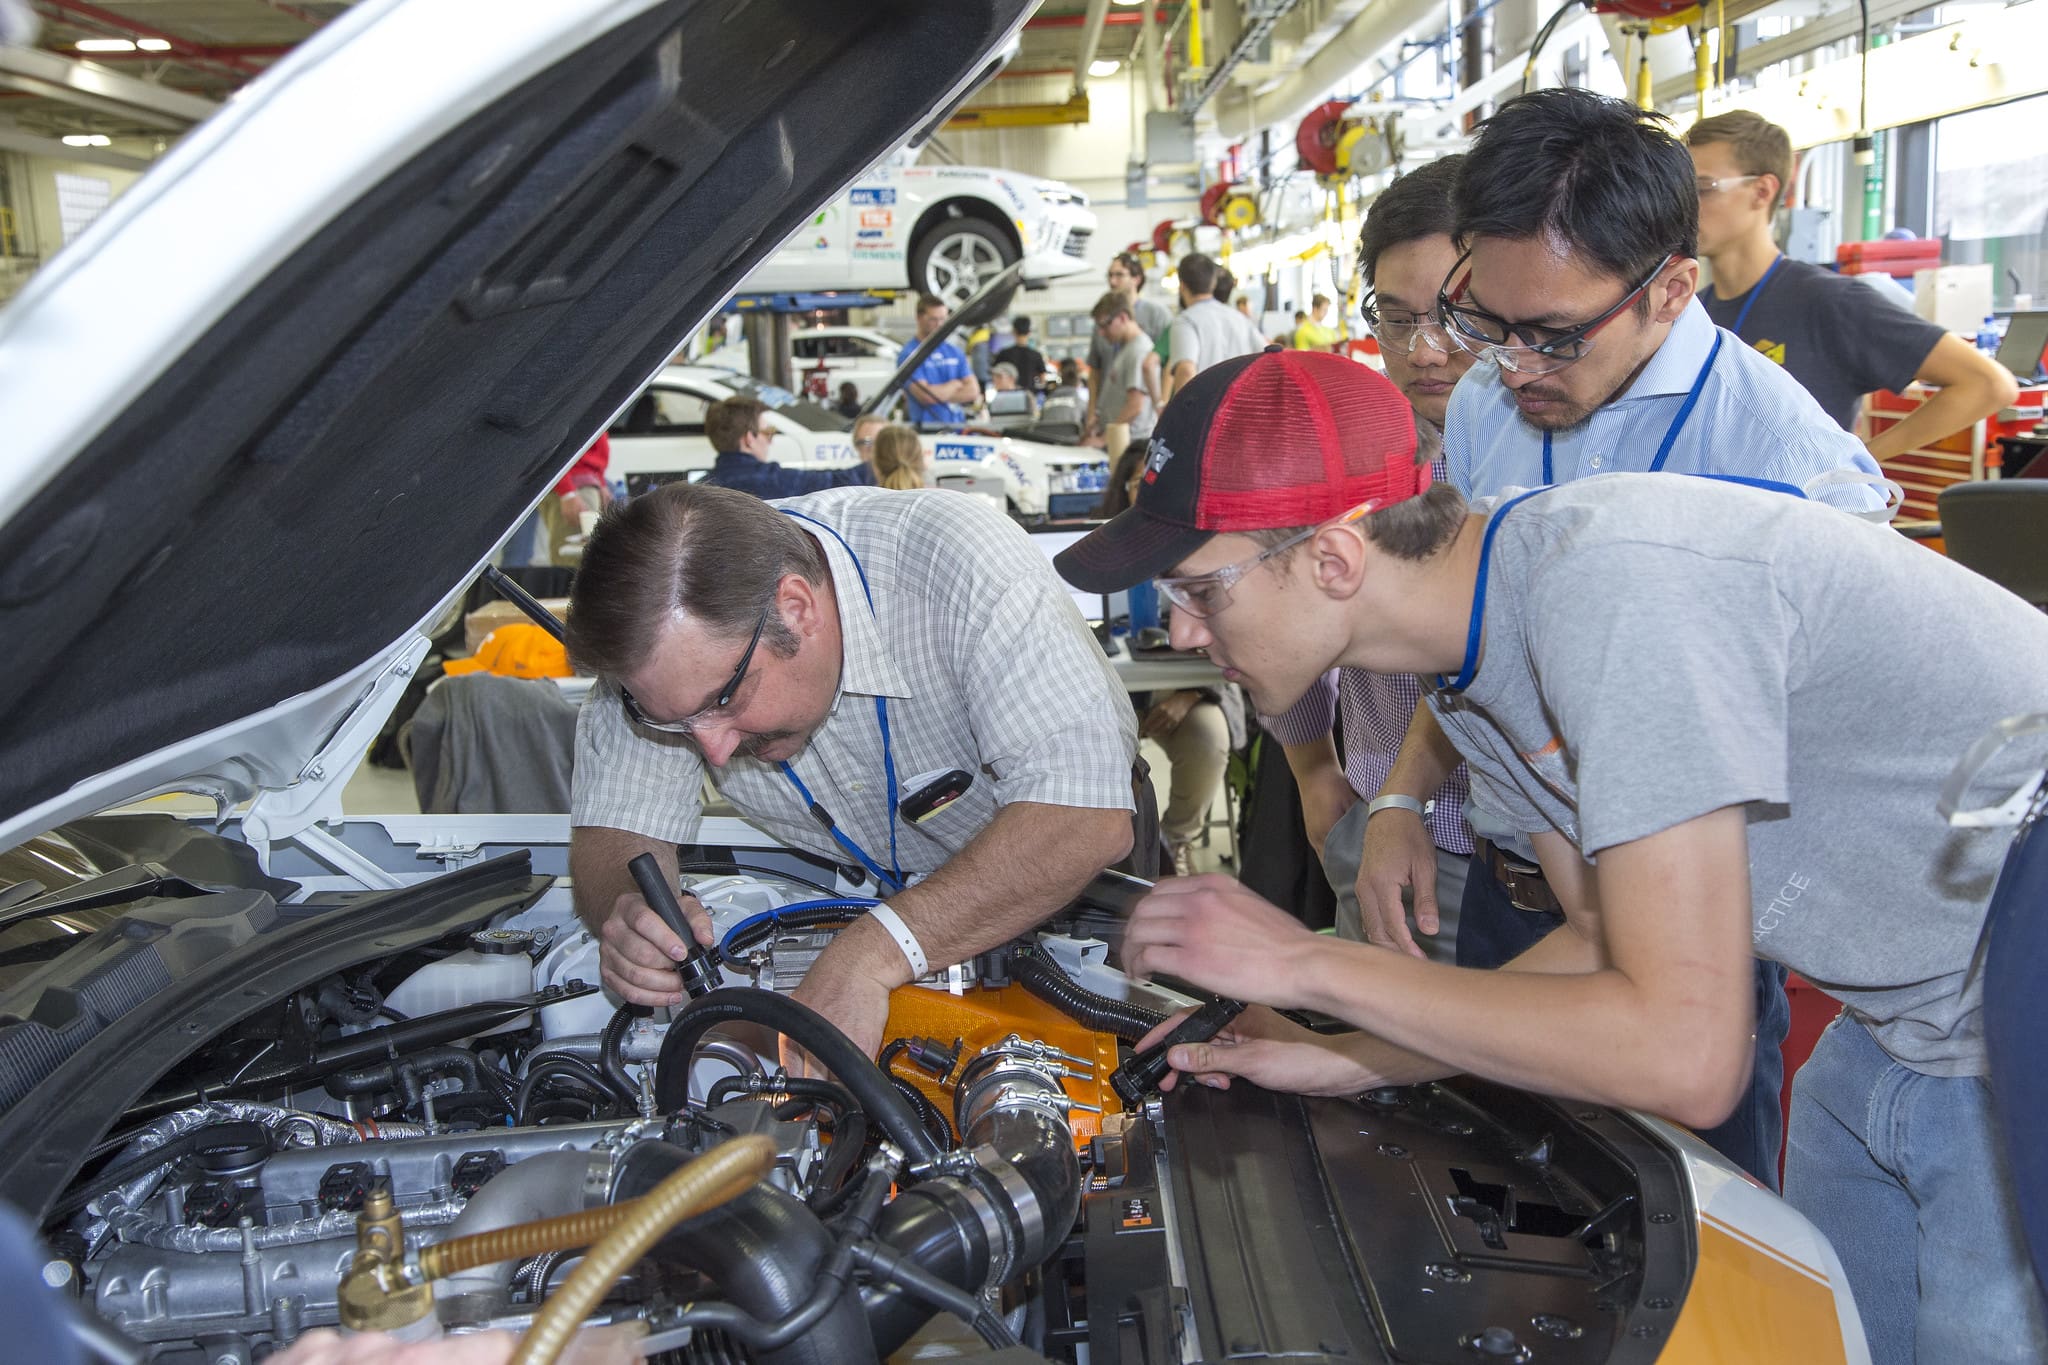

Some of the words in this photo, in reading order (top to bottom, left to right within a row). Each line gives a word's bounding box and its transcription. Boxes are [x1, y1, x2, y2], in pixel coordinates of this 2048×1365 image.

[851, 191, 875, 203] AVL
[815, 444, 859, 459] ETA
[936, 446, 968, 459] AVL
[1752, 871, 1811, 944] ACTICE
